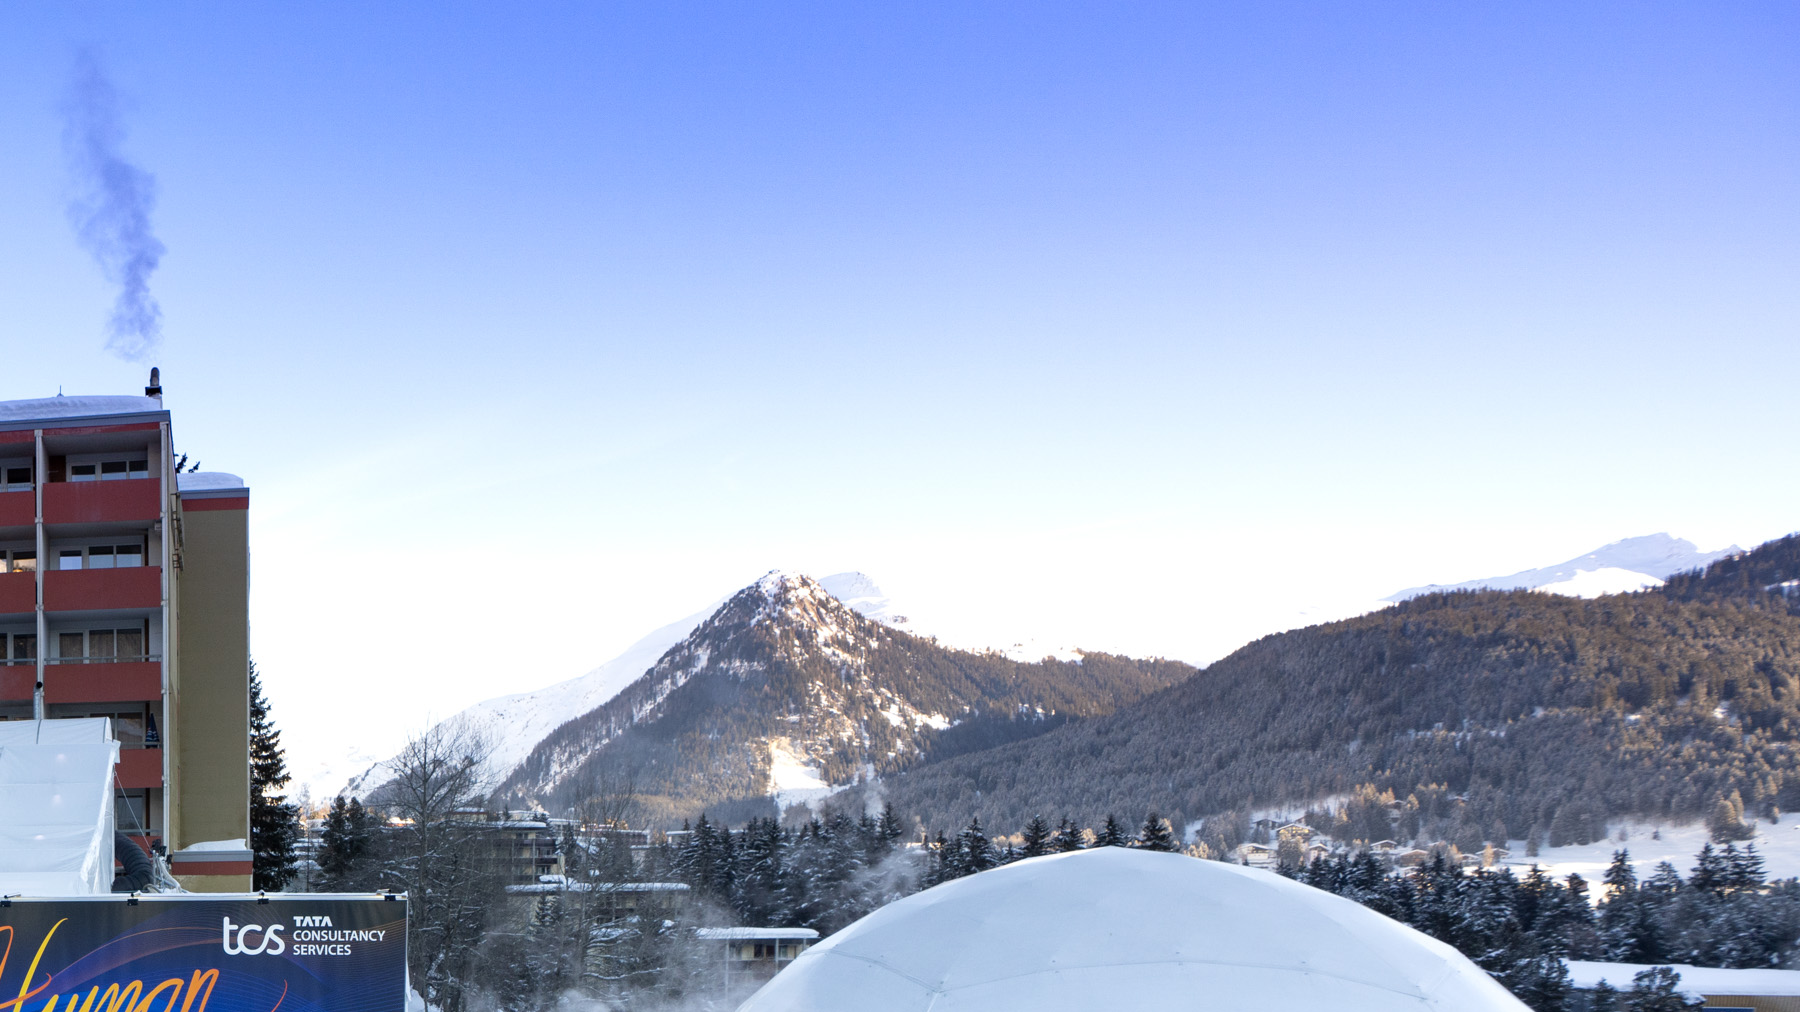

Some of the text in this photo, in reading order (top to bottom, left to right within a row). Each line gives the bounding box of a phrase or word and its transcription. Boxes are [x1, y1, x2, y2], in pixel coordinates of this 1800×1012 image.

[293, 916, 332, 928] TATA
[222, 916, 285, 956] tcs
[293, 929, 386, 942] CONSULTANCY
[293, 944, 351, 956] SERVICES
